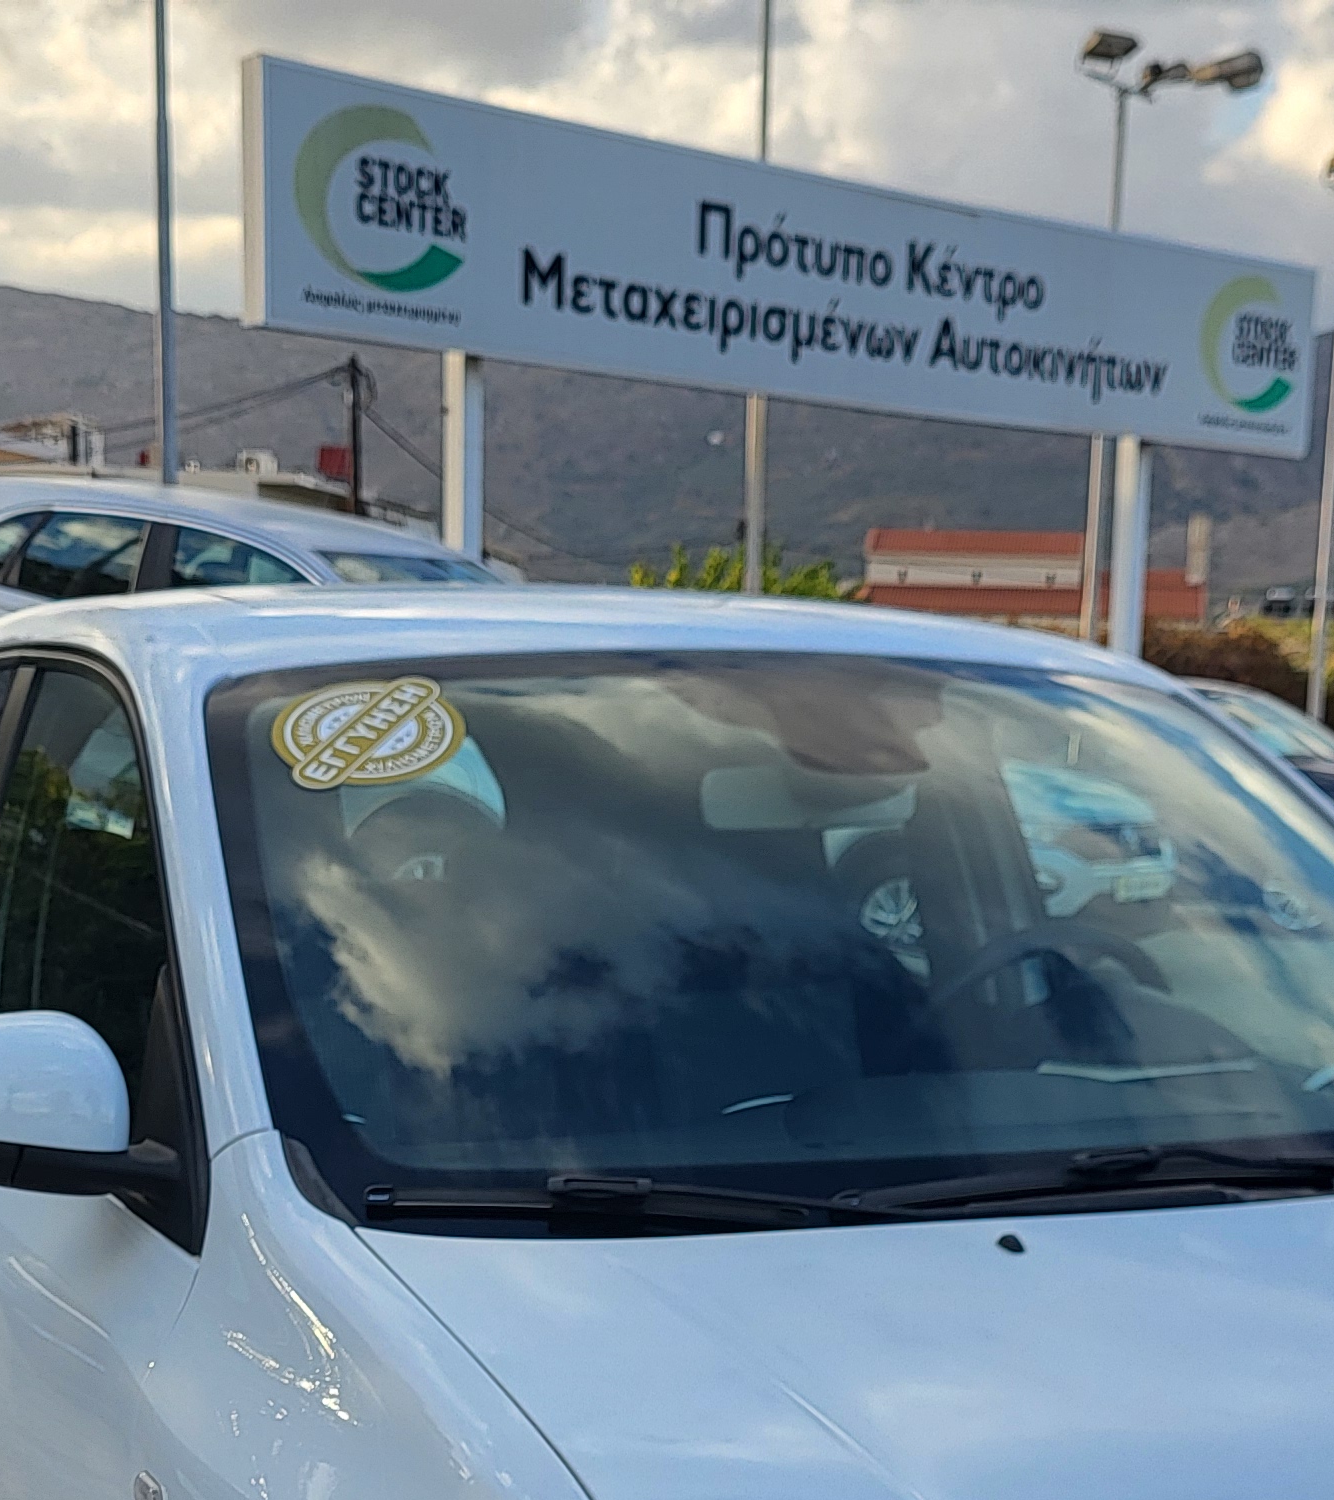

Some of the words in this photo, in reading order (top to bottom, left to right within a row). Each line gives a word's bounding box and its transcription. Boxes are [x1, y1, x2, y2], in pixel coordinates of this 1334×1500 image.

[356, 193, 466, 242] CENTER
[357, 157, 450, 204] STOCK
[699, 200, 893, 286] Πρότυπο
[907, 241, 1044, 319] Κέντρο
[522, 247, 919, 366] Μεταχειρισμένων
[929, 317, 1167, 404] Αυτοκινήτων
[303, 683, 429, 782] ΕΓΓΥΗΣΗ
